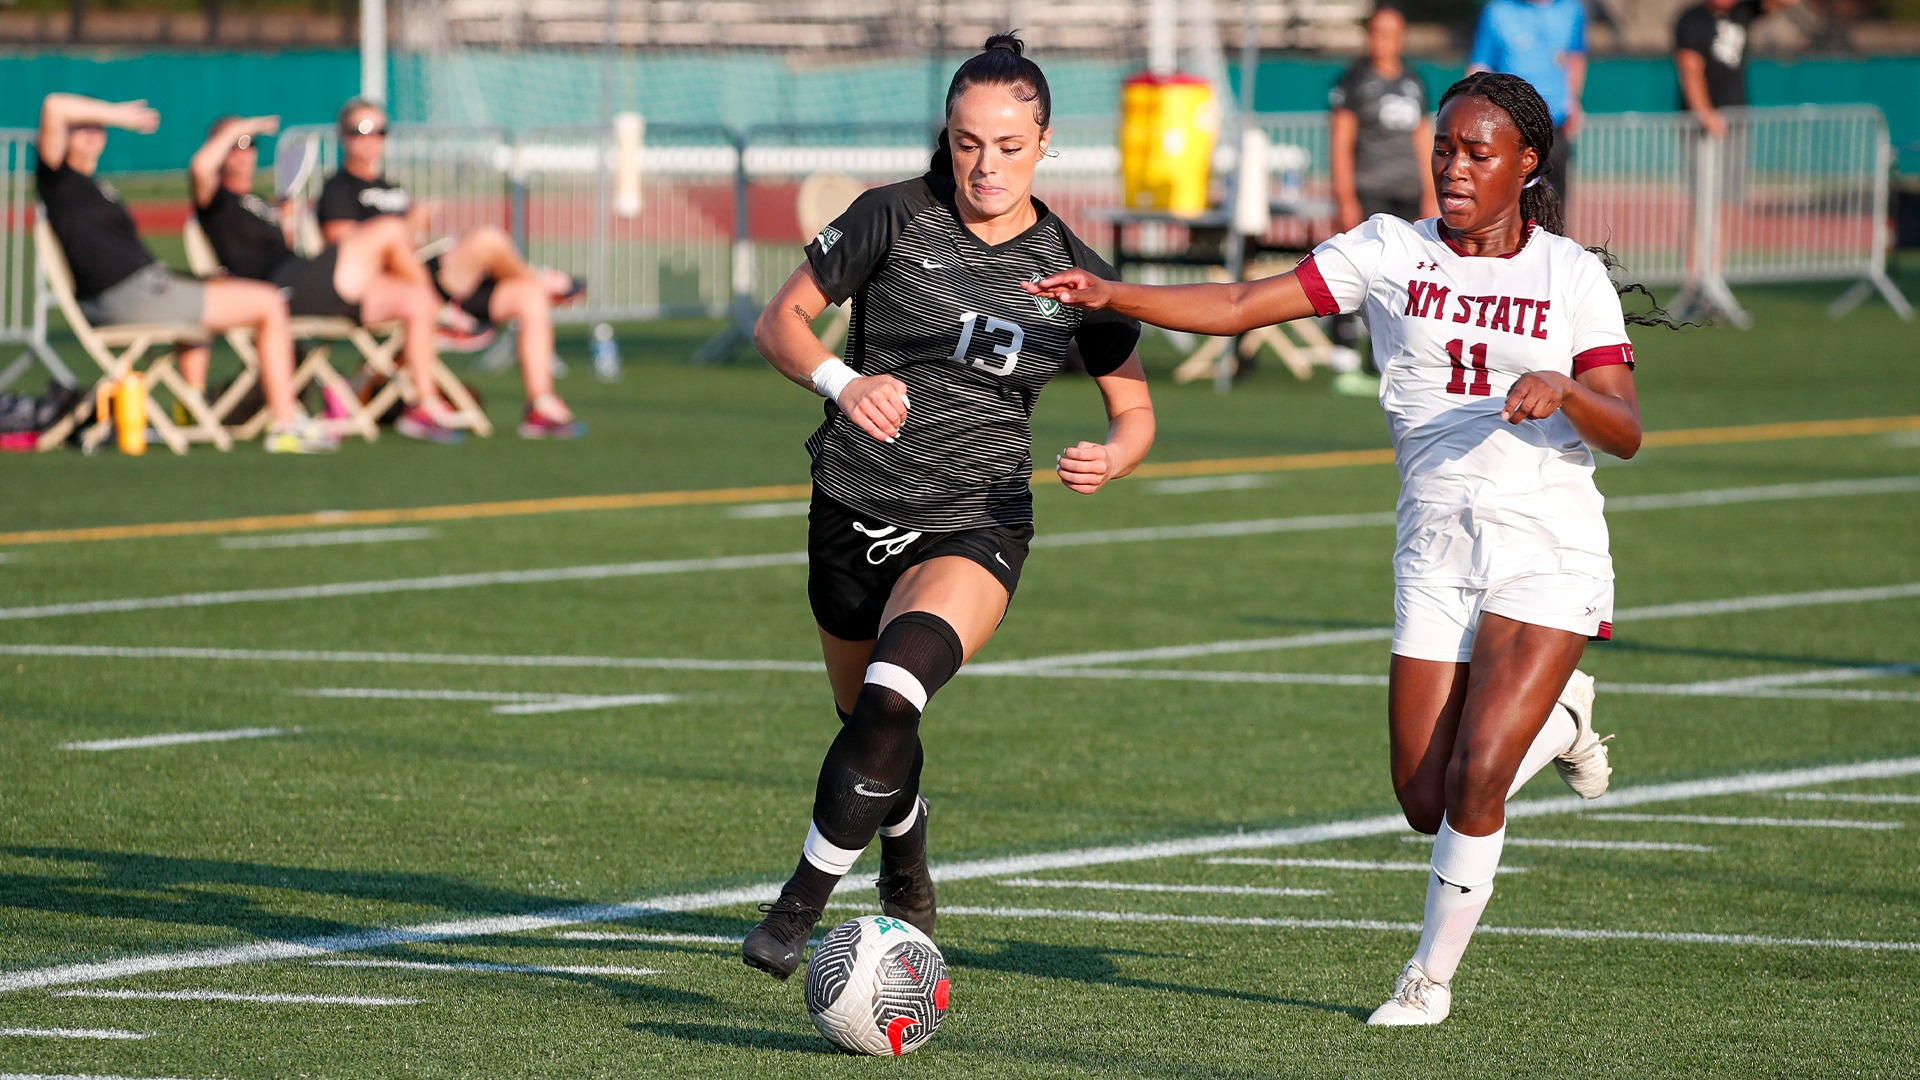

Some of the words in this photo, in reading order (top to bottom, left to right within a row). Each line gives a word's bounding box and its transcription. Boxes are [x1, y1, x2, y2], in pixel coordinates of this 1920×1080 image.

[1404, 280, 1451, 320] NM
[1452, 295, 1551, 340] STATE
[948, 312, 1025, 376] 13
[1445, 338, 1491, 396] 11
